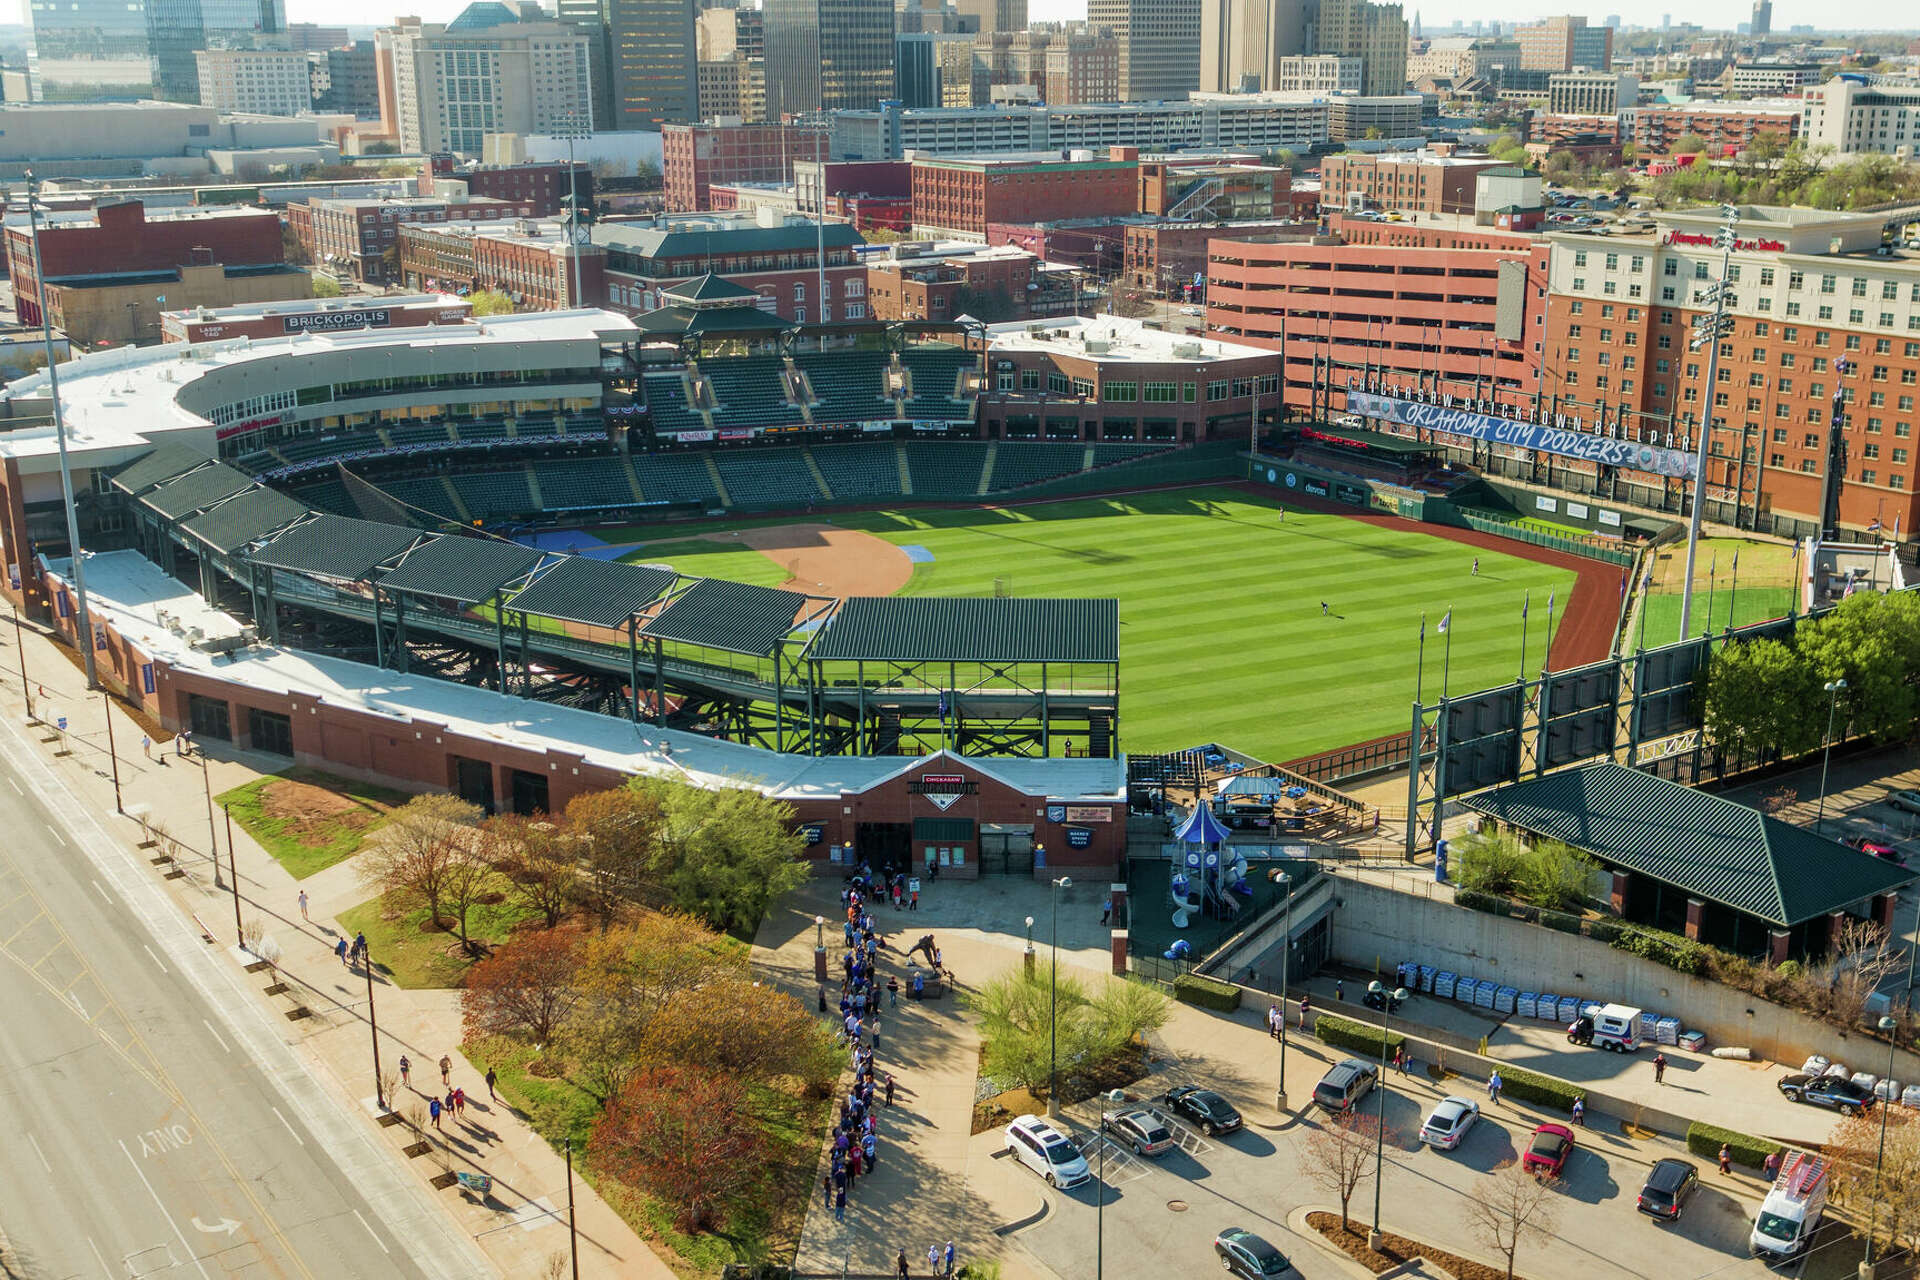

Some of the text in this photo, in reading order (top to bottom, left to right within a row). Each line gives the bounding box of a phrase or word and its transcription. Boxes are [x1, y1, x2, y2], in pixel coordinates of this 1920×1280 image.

[1663, 231, 1712, 247] Hampton
[289, 312, 385, 327] BRICKOPOLIS
[1348, 376, 1453, 408] CHICKASAW
[1464, 397, 1583, 432] BRICKTOWN
[1594, 420, 1690, 452] BALLPAR
[1406, 402, 1491, 439] OKLAHOMA
[1495, 419, 1535, 447] CITY
[1538, 427, 1630, 464] DODGERS
[137, 1125, 193, 1159] ONLY
